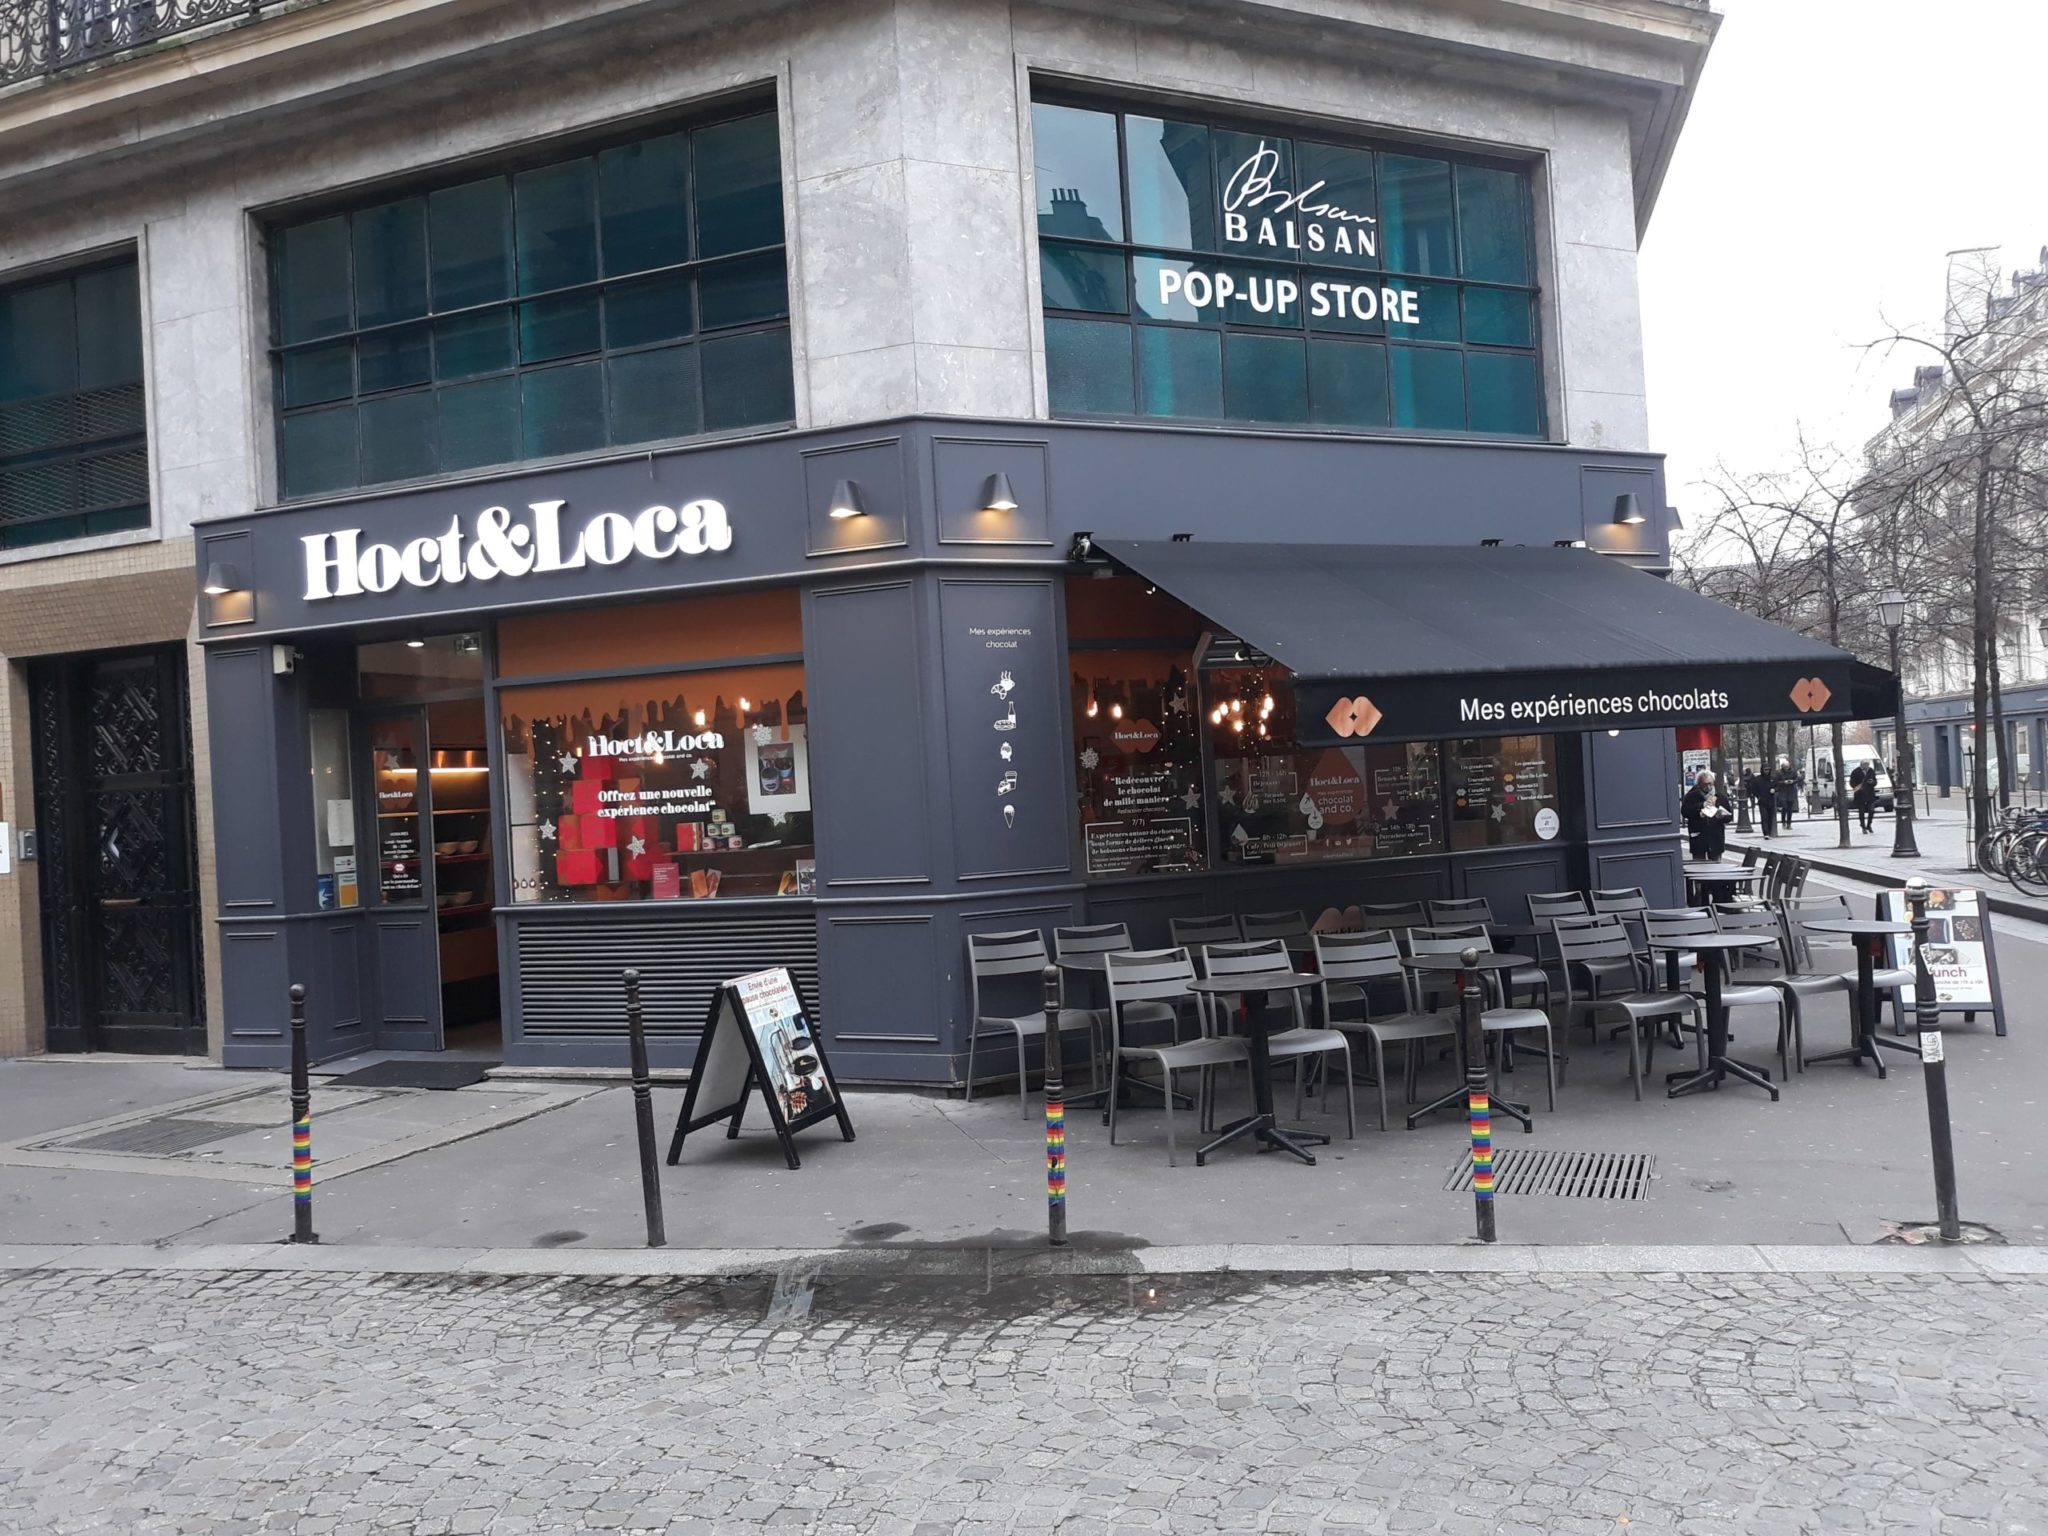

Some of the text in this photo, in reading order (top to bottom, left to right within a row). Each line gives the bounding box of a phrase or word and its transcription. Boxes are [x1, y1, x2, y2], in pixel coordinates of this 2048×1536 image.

[1224, 212, 1376, 257] BALSAN
[1158, 269, 1420, 324] POP-UP STORE
[300, 499, 732, 600] Hoct&Loca
[969, 627, 986, 636] Mes
[985, 640, 1018, 649] chocolat
[1460, 688, 1729, 724] Mes expériences chocolats
[587, 729, 725, 757] Hoct&Loca
[597, 784, 713, 803] Offrez une nouvelle
[1117, 785, 1161, 796] le chocolat
[1103, 798, 1113, 807] de
[1114, 796, 1136, 806] mille
[1318, 795, 1354, 805] chocolat
[597, 803, 660, 819] expérience
[1319, 804, 1337, 815] and
[747, 981, 763, 991] Envie
